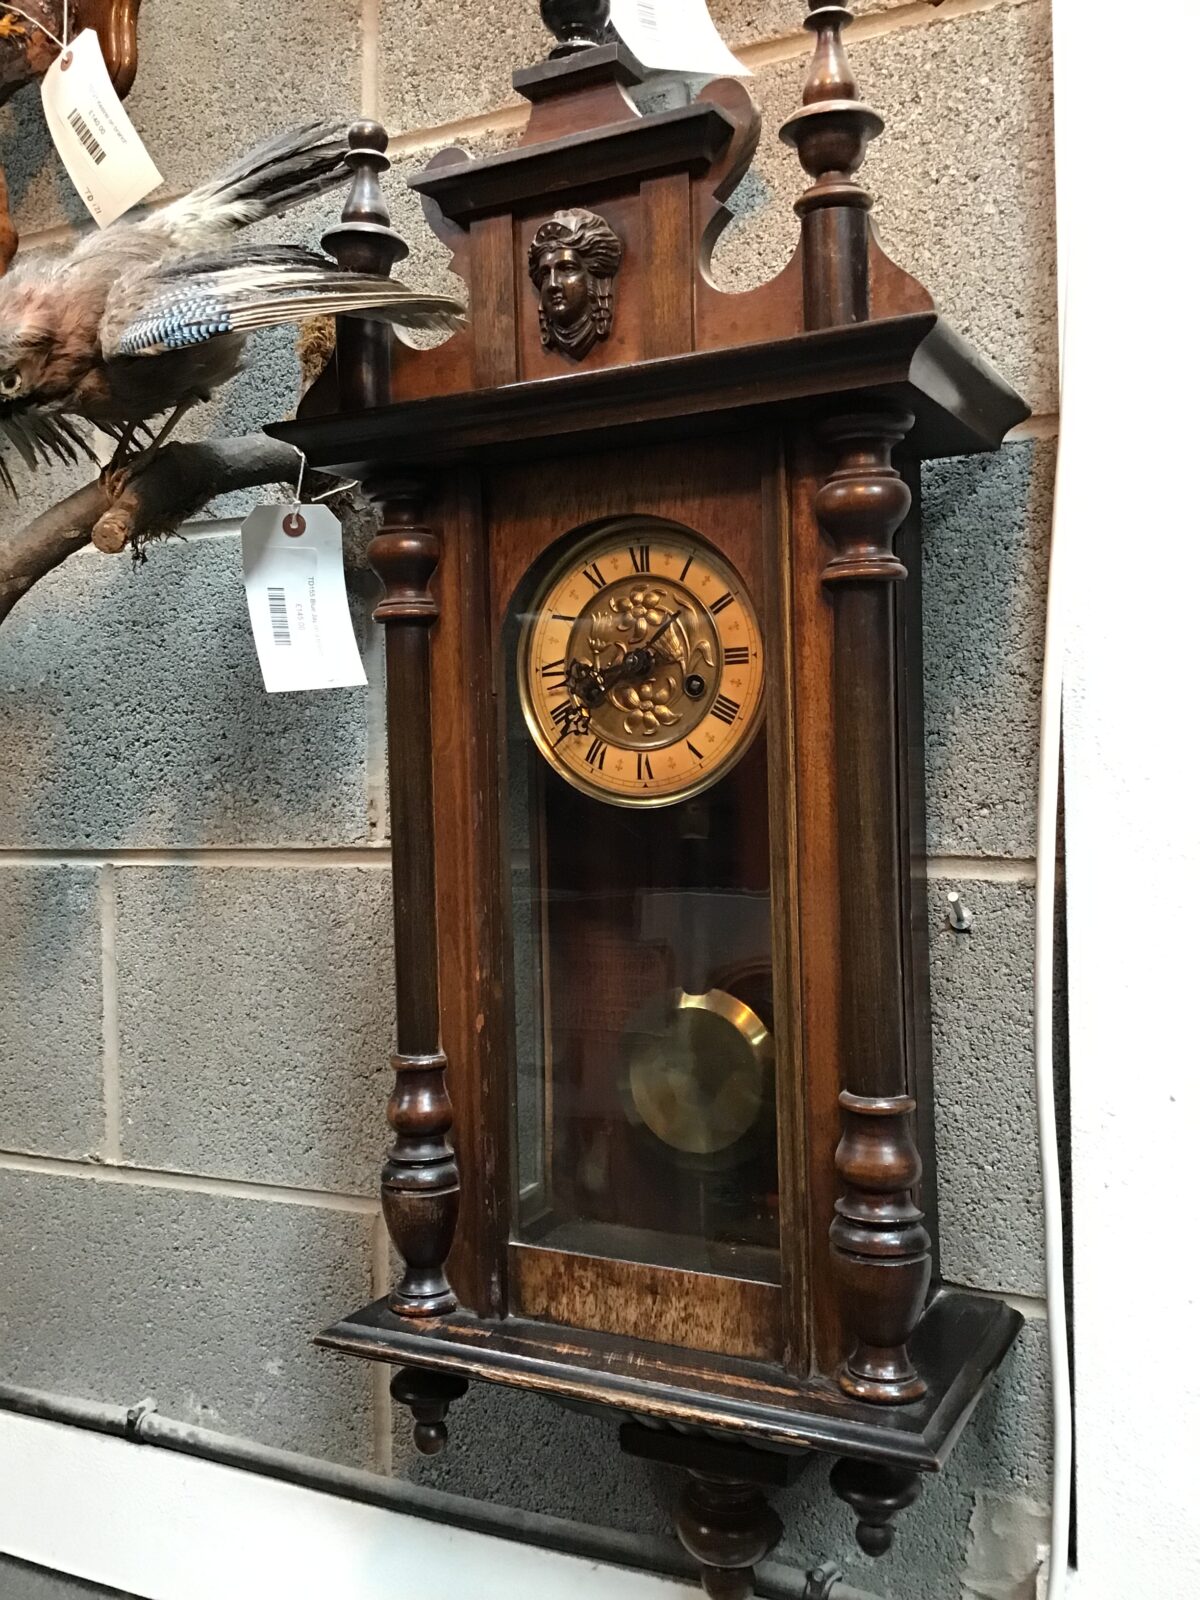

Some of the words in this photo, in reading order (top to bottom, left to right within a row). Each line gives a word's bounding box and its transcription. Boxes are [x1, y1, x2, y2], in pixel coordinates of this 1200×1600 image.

[709, 591, 736, 616] II
[724, 647, 749, 666] III
[710, 694, 741, 726] IIII
